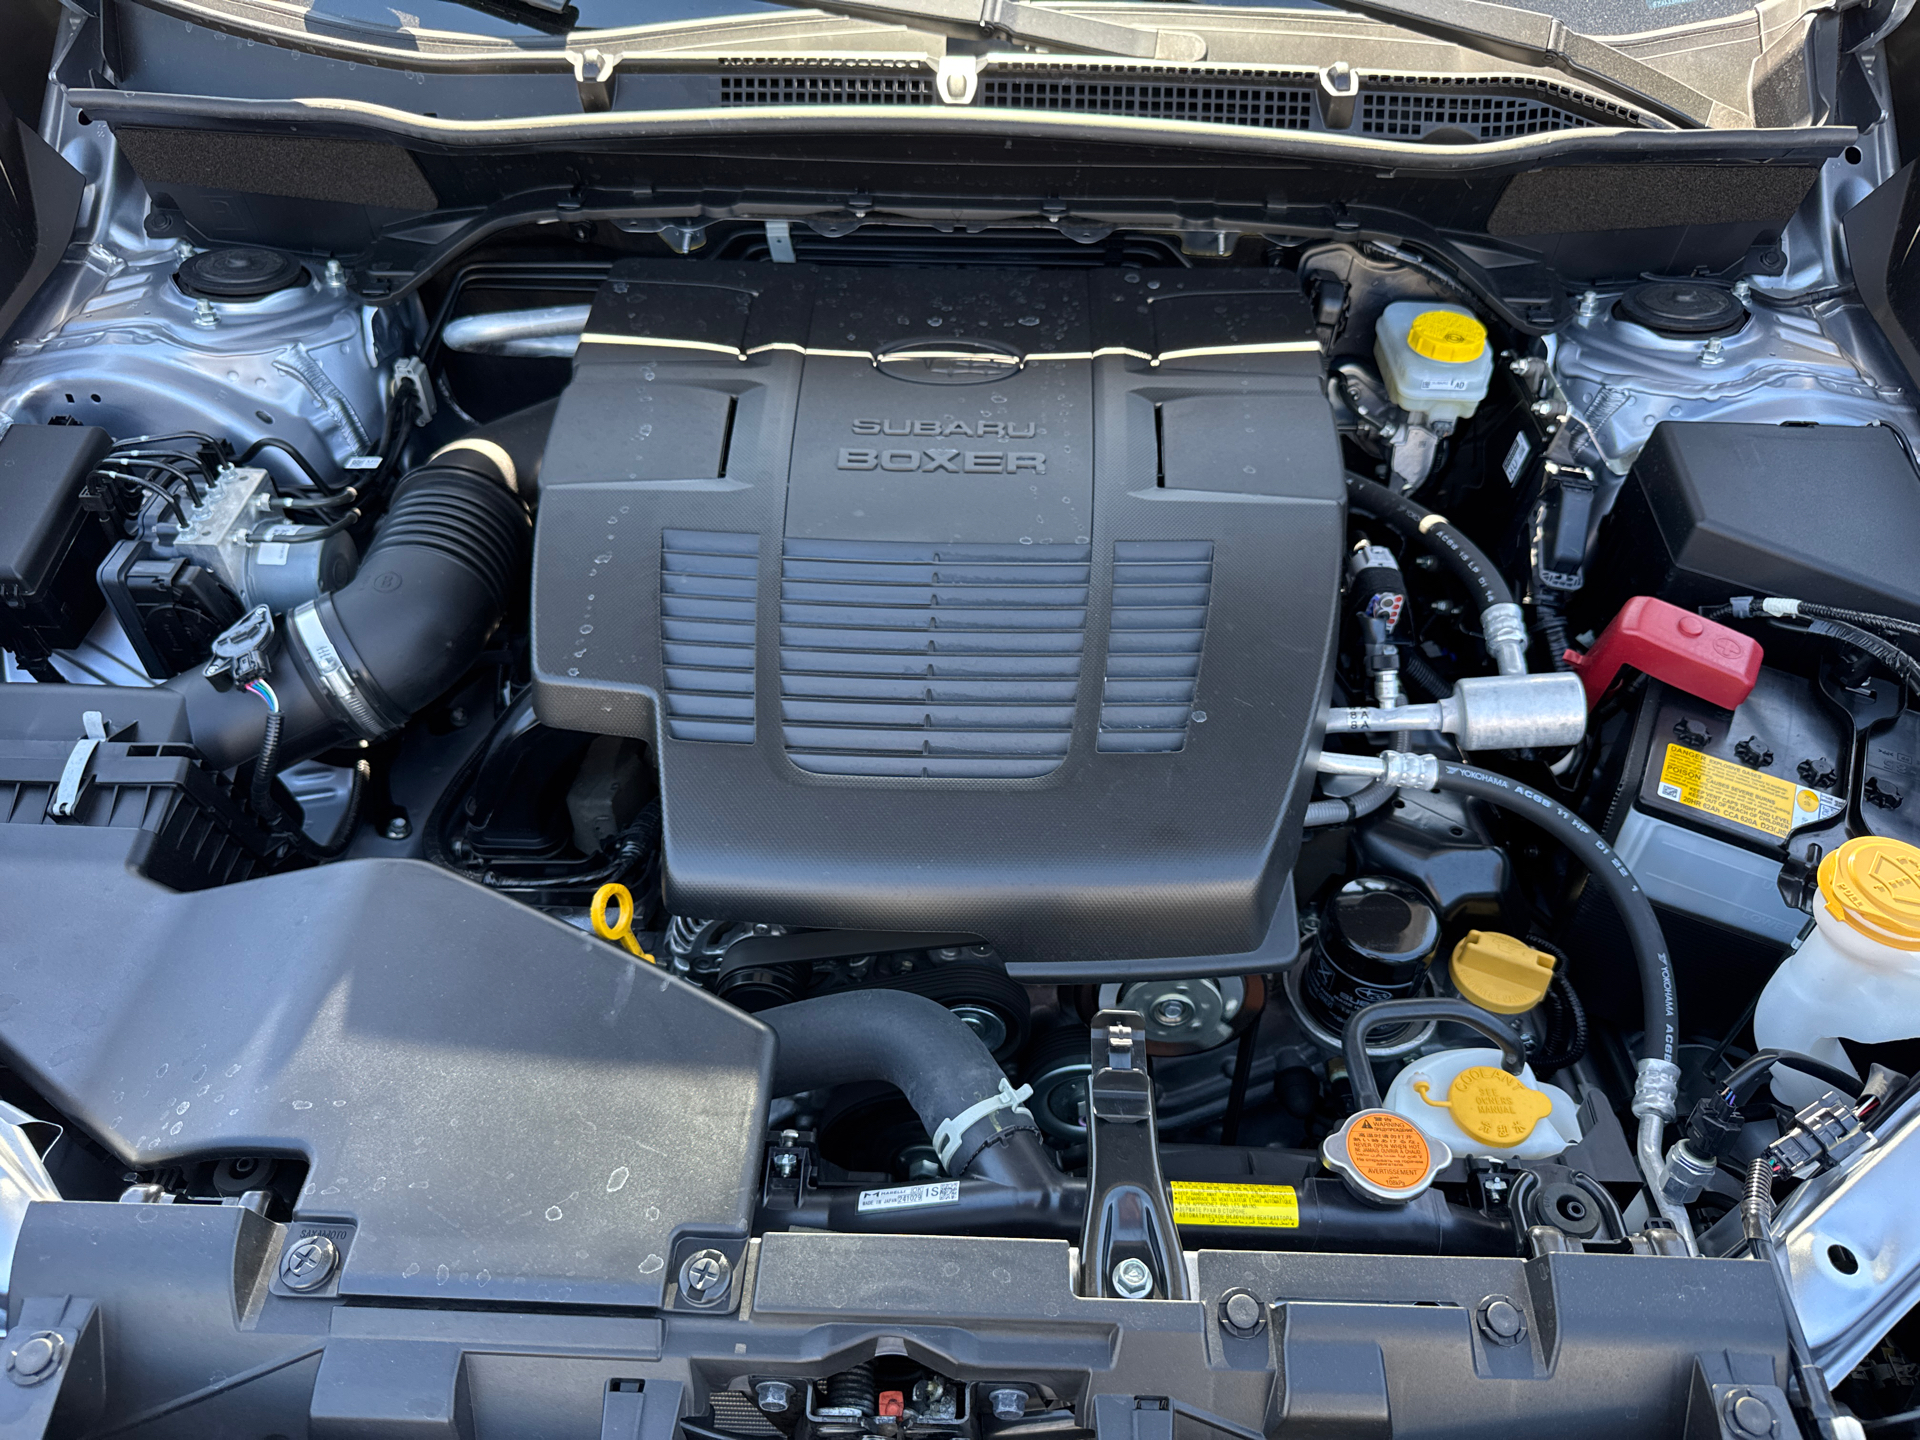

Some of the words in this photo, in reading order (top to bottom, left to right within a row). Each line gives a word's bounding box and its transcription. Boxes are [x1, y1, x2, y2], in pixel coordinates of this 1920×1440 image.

[852, 418, 1036, 439] SUBARU
[837, 447, 1047, 475] BOXER
[1435, 530, 1458, 551] AC6B
[1457, 550, 1469, 561] 15
[1466, 560, 1479, 574] LP
[1350, 720, 1357, 729] 8
[1360, 720, 1369, 728] A
[1670, 745, 1706, 761] DANGER
[1708, 758, 1740, 772] EXPLOSIVE
[1741, 769, 1762, 779] GASES
[1666, 764, 1701, 780] POISON
[1705, 777, 1729, 789] CAUSES
[1730, 785, 1753, 797] SEVERE
[1754, 793, 1776, 805] BURNS
[1682, 795, 1701, 806] 20HR
[1702, 802, 1720, 813] 62Ah
[1722, 809, 1739, 819] CCA
[1739, 815, 1758, 826] 620A
[1687, 791, 1703, 800] KEEP
[1704, 796, 1717, 805] OUT
[1726, 804, 1748, 815] REACH
[1758, 815, 1789, 829] CHILDREN
[1689, 786, 1705, 795] KEEP
[1705, 791, 1722, 801] VENT
[1722, 797, 1739, 806] CAPS
[1739, 803, 1757, 813] TIGHT
[1757, 809, 1771, 818] AND
[1771, 813, 1790, 824] LEVEL
[1457, 768, 1509, 788] YOKOHAMA
[1513, 785, 1553, 809] AC6B
[1555, 807, 1570, 820] 11
[1571, 818, 1591, 835] HP
[1593, 839, 1610, 855] DI
[1610, 856, 1630, 878] 22
[1836, 882, 1863, 908] PULL
[1742, 910, 1795, 934] LOWER
[1660, 966, 1673, 1016] YOKOHAMA
[1664, 1023, 1673, 1062] AC6B
[1454, 1067, 1524, 1092] COOLANT
[1478, 1088, 1497, 1096] SEE
[1475, 1096, 1512, 1104] OWNERS
[1477, 1105, 1516, 1114] MANUAL
[1367, 1167, 1417, 1175] AVERTISSEMENT
[925, 1186, 939, 1197] 1S
